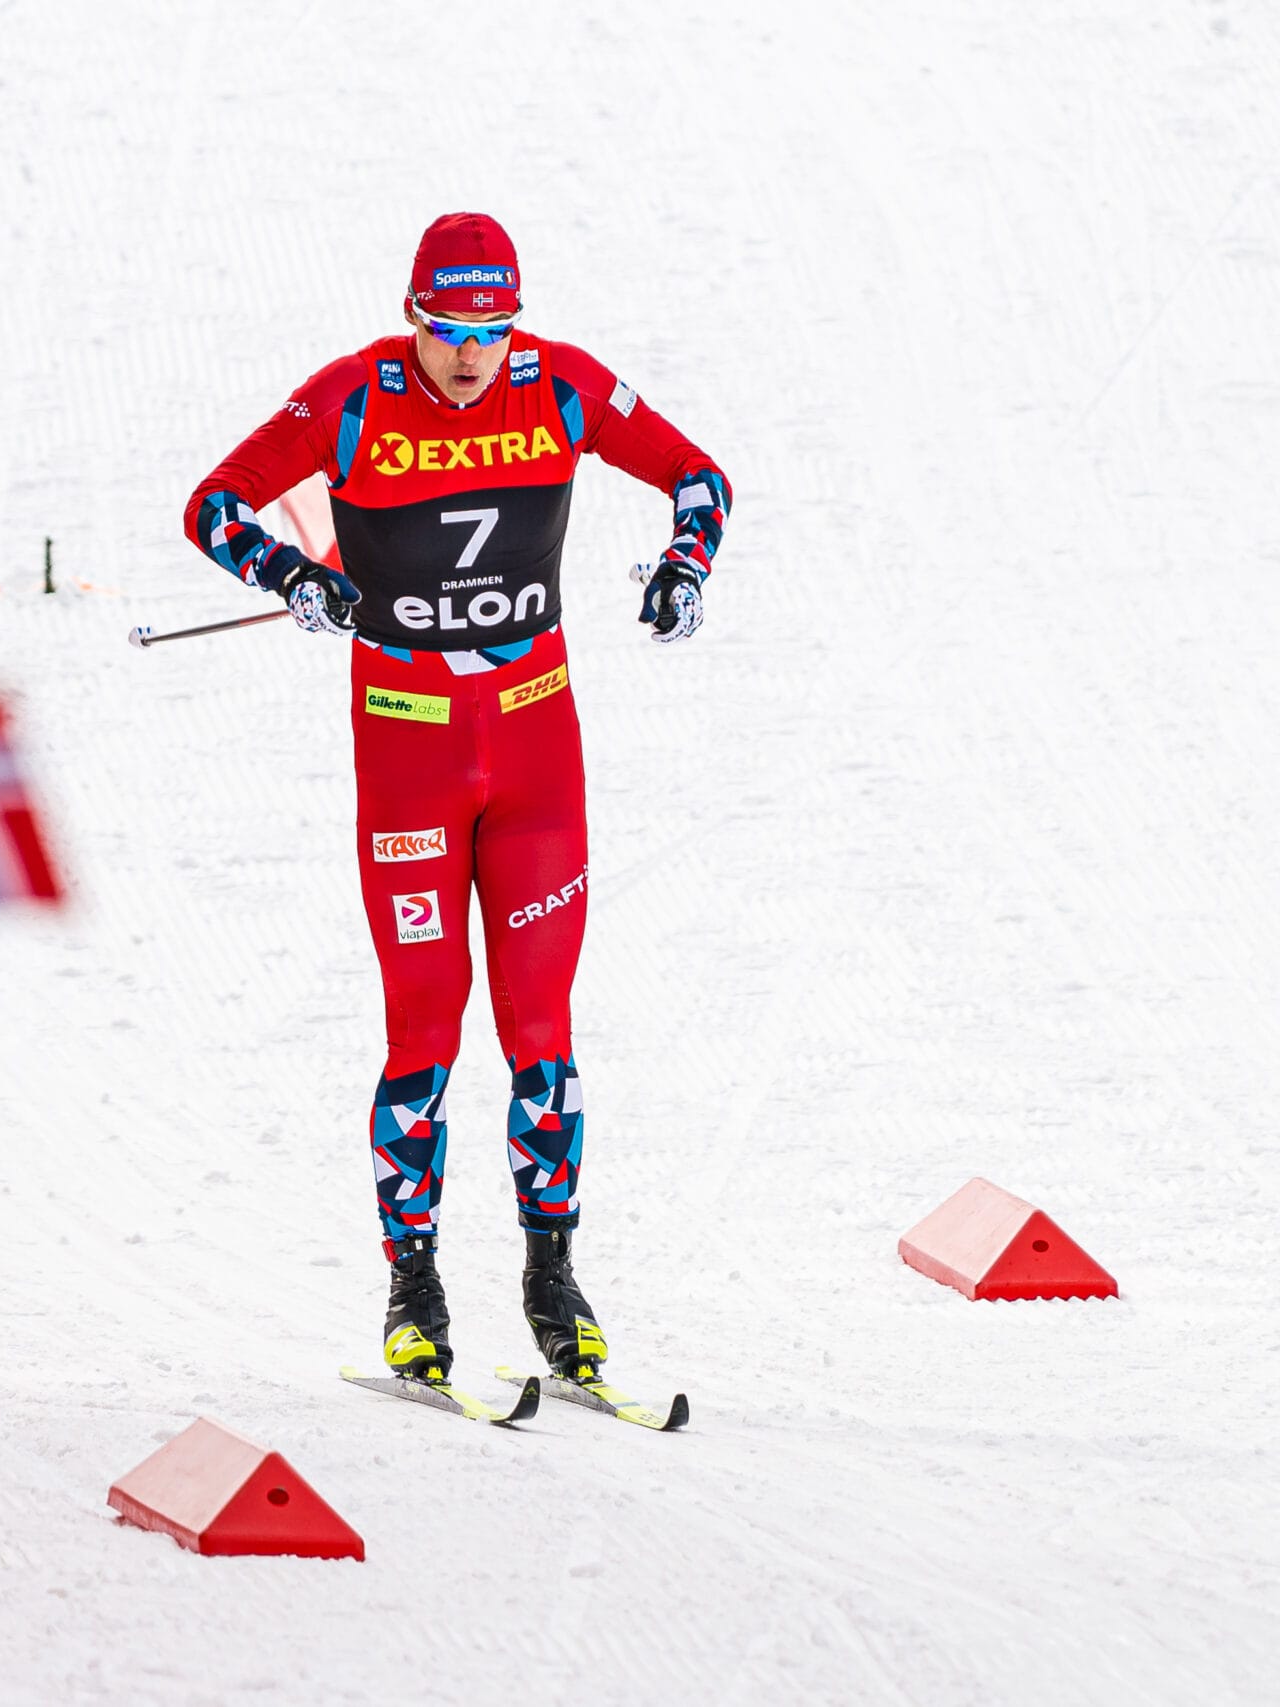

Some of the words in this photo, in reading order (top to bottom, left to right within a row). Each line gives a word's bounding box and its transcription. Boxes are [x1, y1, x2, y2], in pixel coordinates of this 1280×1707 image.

[436, 270, 504, 287] SpareBank
[510, 367, 540, 381] coop
[418, 425, 561, 471] EXTRA
[440, 507, 499, 569] 7
[441, 575, 503, 591] DRAMMEN
[512, 672, 562, 705] DHL
[375, 829, 445, 858] STAYER
[508, 873, 585, 929] CRAFT
[400, 927, 440, 940] viaplay
